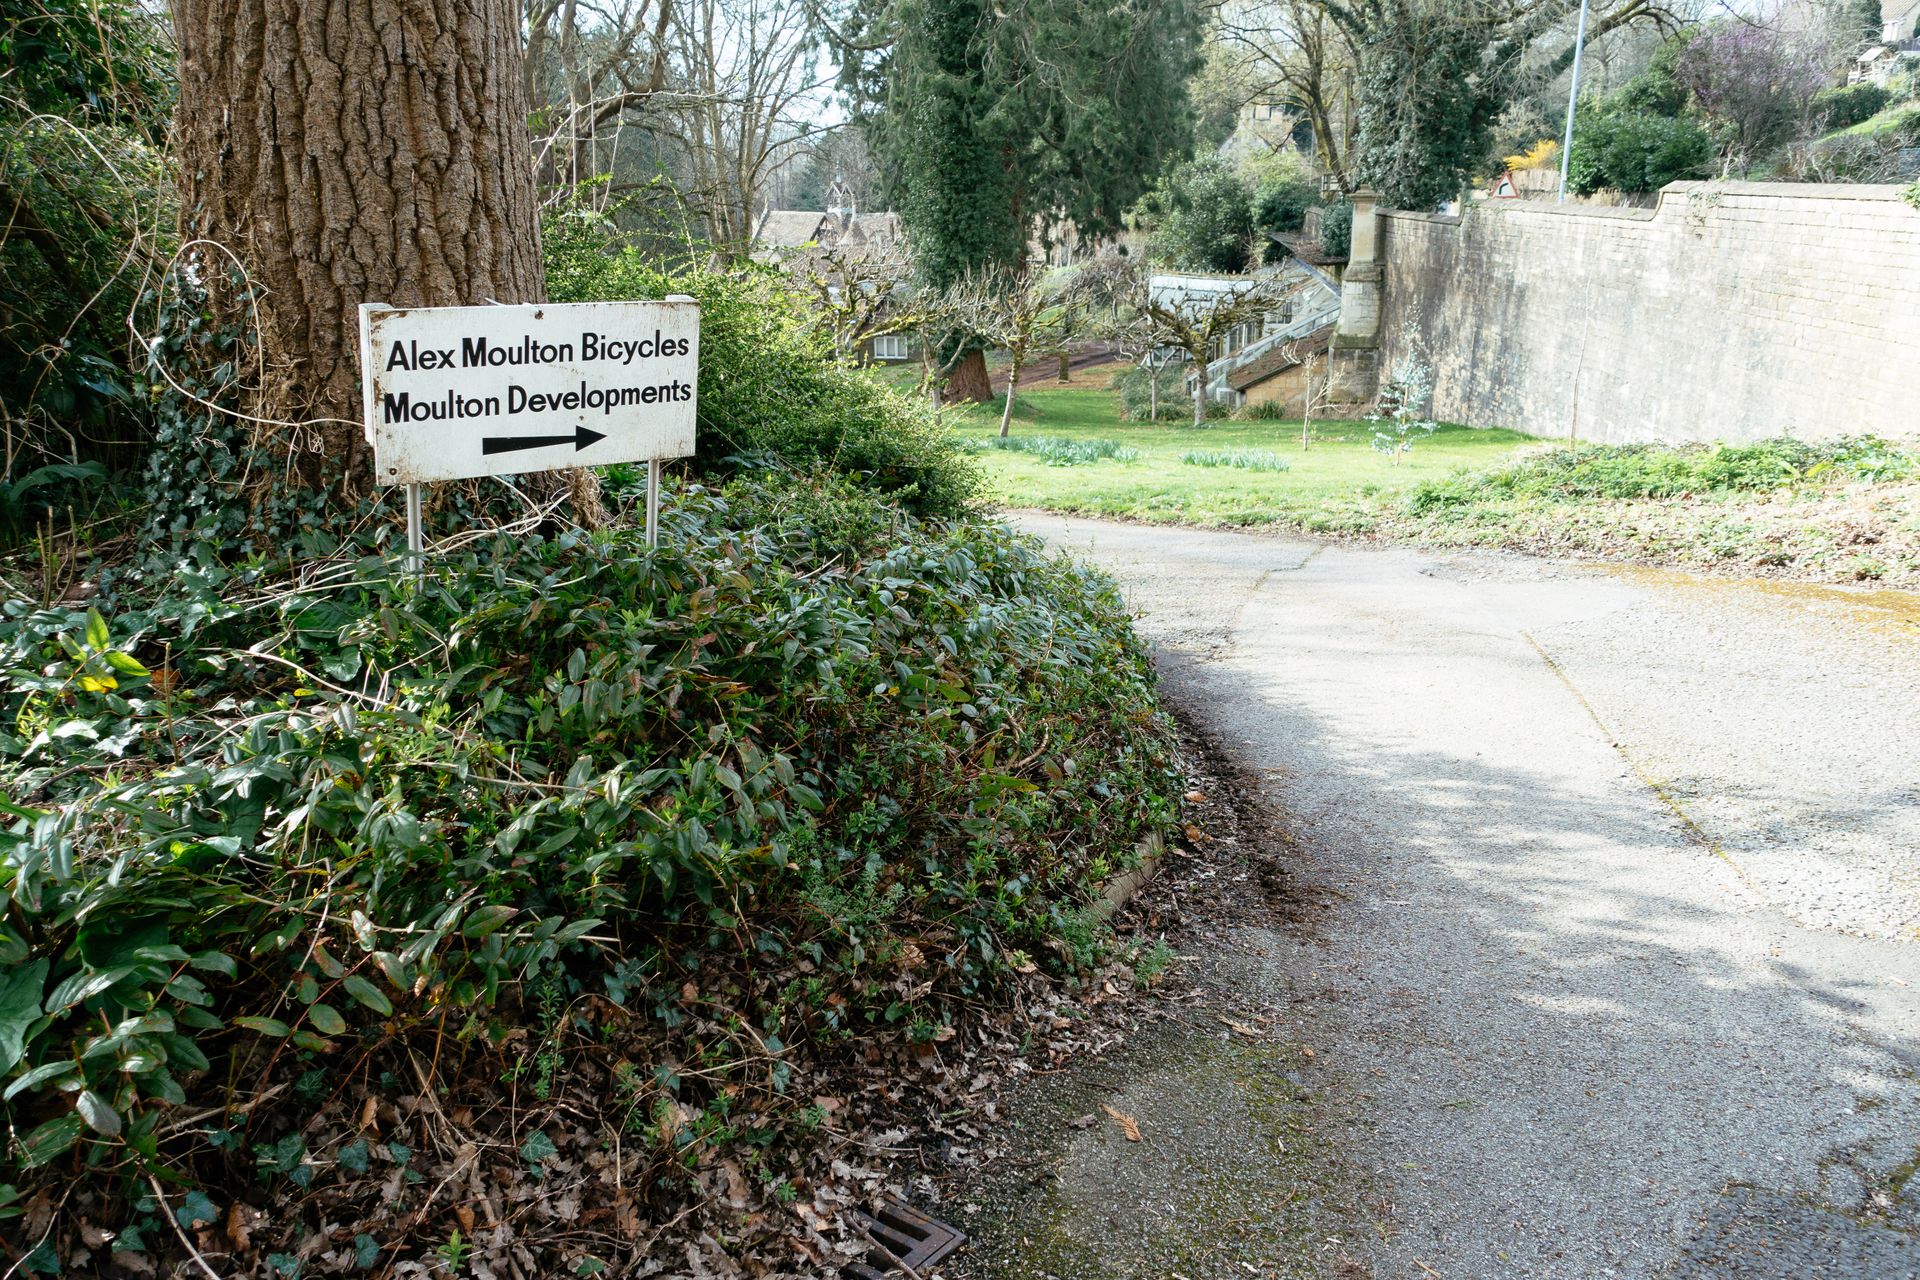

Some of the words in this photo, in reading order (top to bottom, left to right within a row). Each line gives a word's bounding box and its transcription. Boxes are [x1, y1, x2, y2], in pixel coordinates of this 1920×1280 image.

[386, 340, 457, 372] Alex
[462, 335, 573, 368] Moulton
[581, 329, 690, 365] Bicycles
[384, 389, 501, 424] Moulton
[508, 379, 692, 415] Developments
